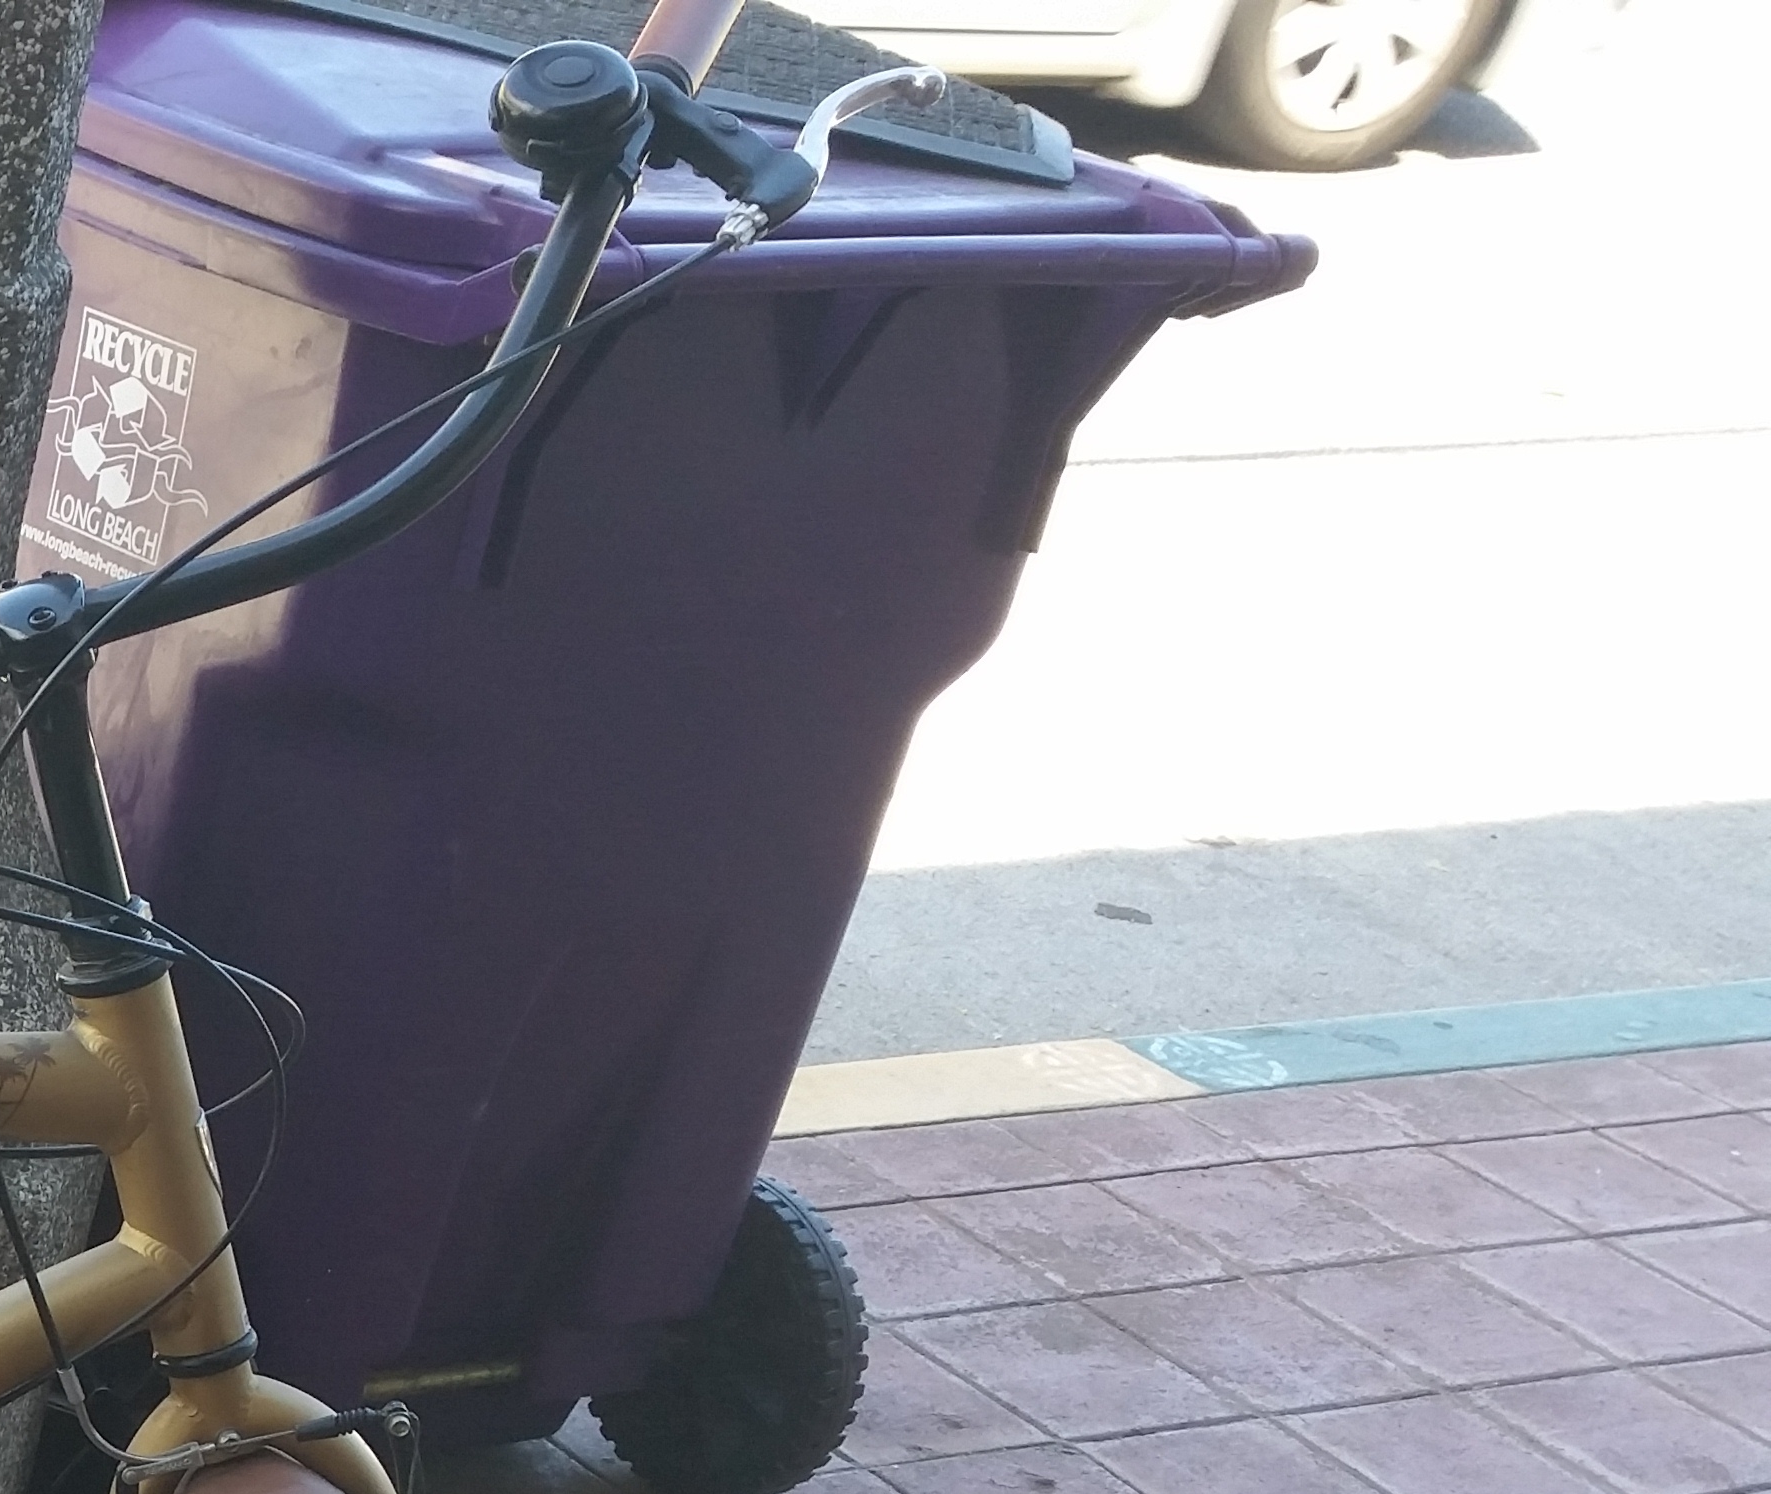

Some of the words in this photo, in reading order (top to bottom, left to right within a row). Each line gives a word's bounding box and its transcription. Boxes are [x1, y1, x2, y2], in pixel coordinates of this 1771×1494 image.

[82, 317, 192, 396] RECYCLE
[52, 490, 101, 535] LONG
[103, 511, 158, 561] BEACH
